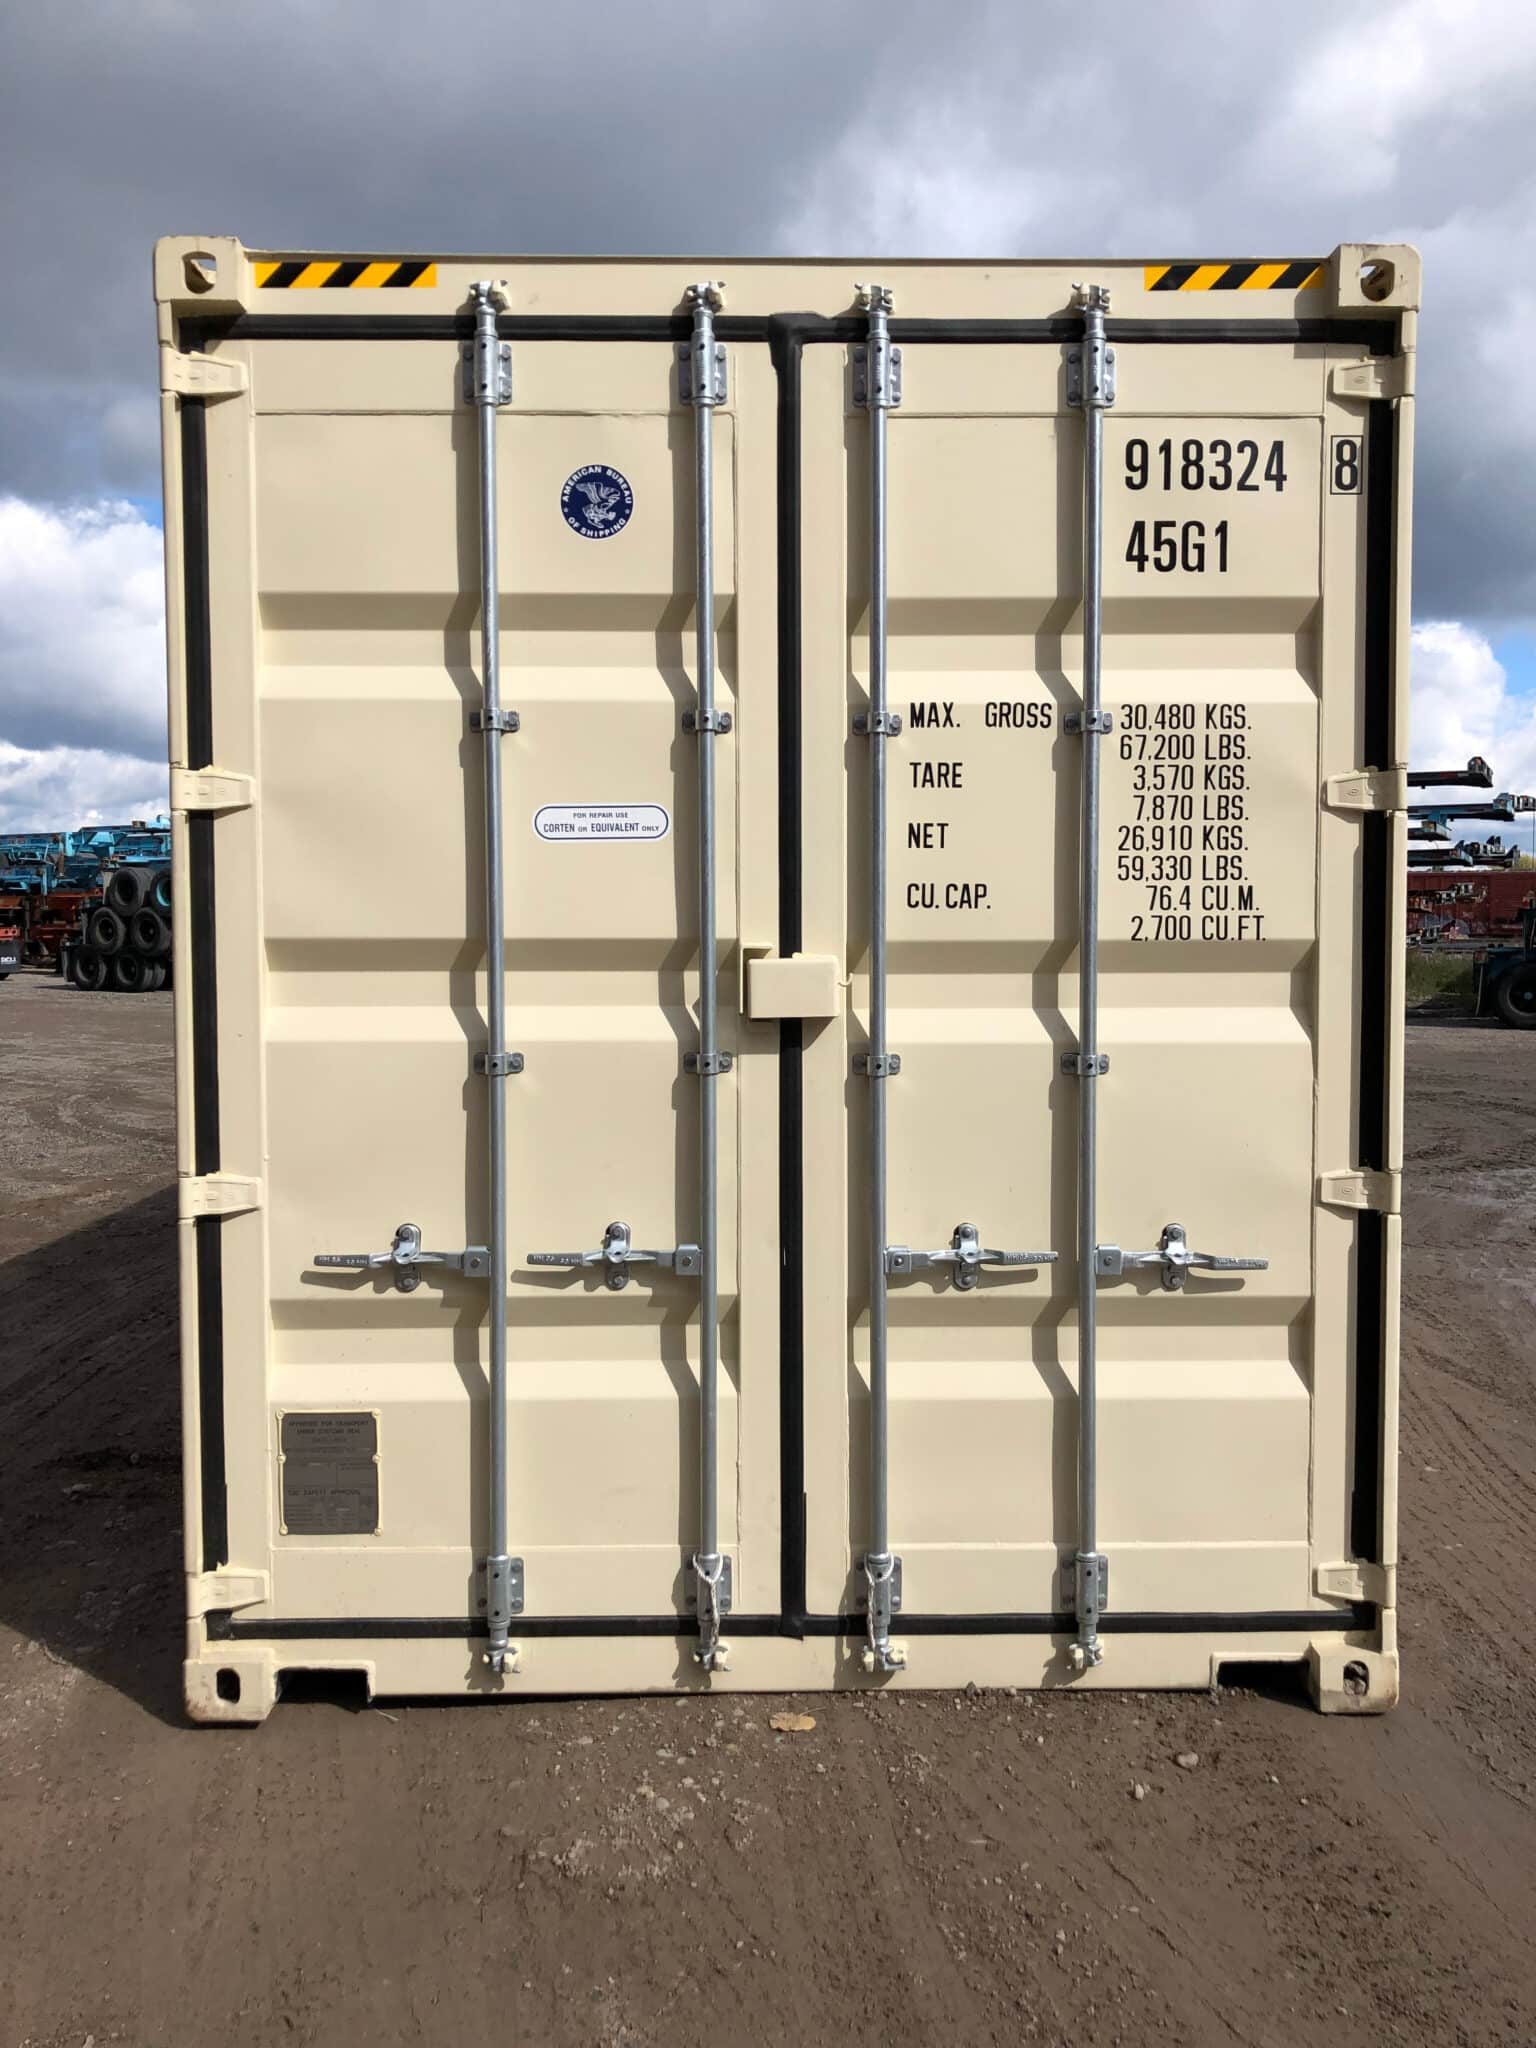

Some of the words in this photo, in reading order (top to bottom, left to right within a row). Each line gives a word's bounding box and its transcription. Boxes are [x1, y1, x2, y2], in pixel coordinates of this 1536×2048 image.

[1125, 438, 1288, 492] 918324
[1335, 439, 1358, 491] 8
[562, 466, 602, 503] AMERICAN
[606, 469, 632, 504] BUREAU
[568, 516, 581, 529] OF
[580, 518, 626, 538] SHIPPING
[1125, 520, 1229, 573] 45G1
[910, 702, 961, 729] MAX.
[985, 702, 1052, 729] GROSS
[1120, 703, 1195, 731] 30,480
[1205, 703, 1252, 730] KGS.
[1119, 734, 1195, 761] 67,200
[1204, 734, 1252, 760] LBS.
[909, 762, 963, 789] TARE
[1133, 764, 1194, 792] 3,570
[1203, 764, 1250, 790] KGS.
[1133, 794, 1193, 822] 7,870
[1203, 794, 1249, 820] LBS.
[543, 823, 575, 833] CORTEN
[591, 822, 640, 833] EQUIVALENT
[908, 822, 949, 849] NET
[1118, 825, 1193, 852] 26,910
[1202, 825, 1249, 851] KGS.
[1117, 855, 1192, 882] 59,330
[1202, 855, 1248, 881] LBS.
[1145, 885, 1191, 911] 76.4
[1130, 915, 1192, 942] 2,700
